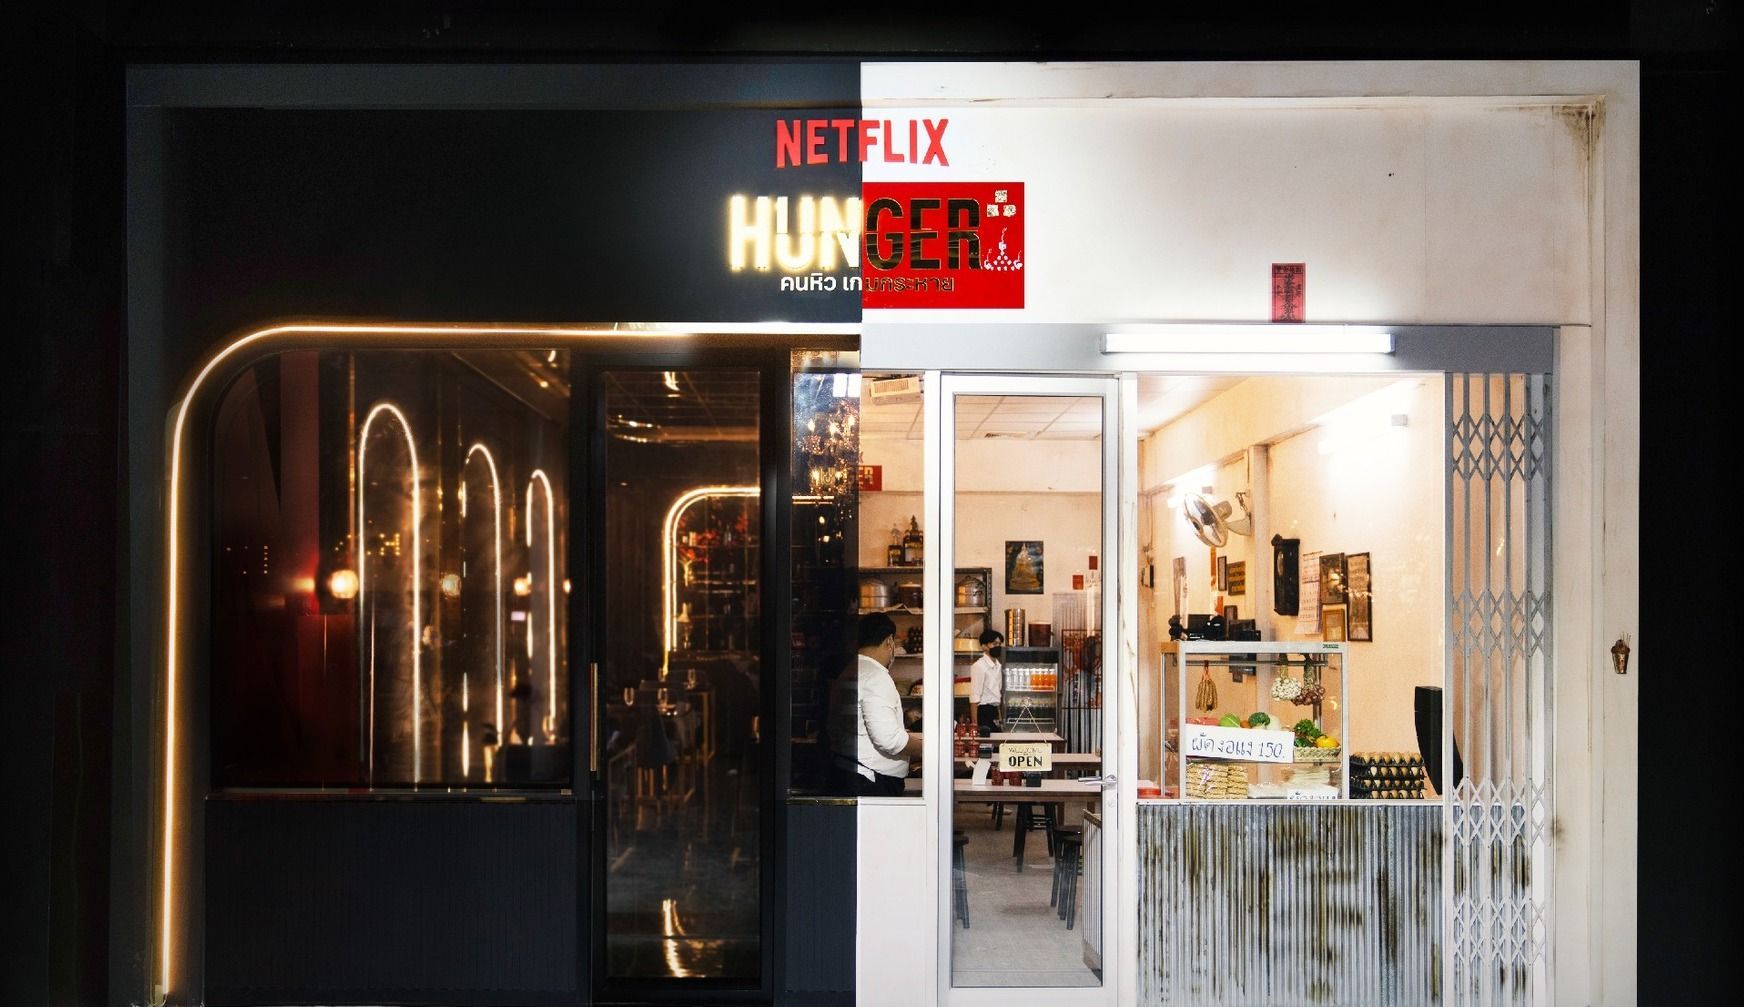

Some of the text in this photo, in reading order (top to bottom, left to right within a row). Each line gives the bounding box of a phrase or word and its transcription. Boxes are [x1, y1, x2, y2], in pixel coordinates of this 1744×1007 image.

[776, 118, 949, 168] NETFLIX
[729, 194, 983, 271] HUNGER
[780, 272, 955, 292] คนหิว เกมกระหาย
[1008, 755, 1043, 767] OPEN
